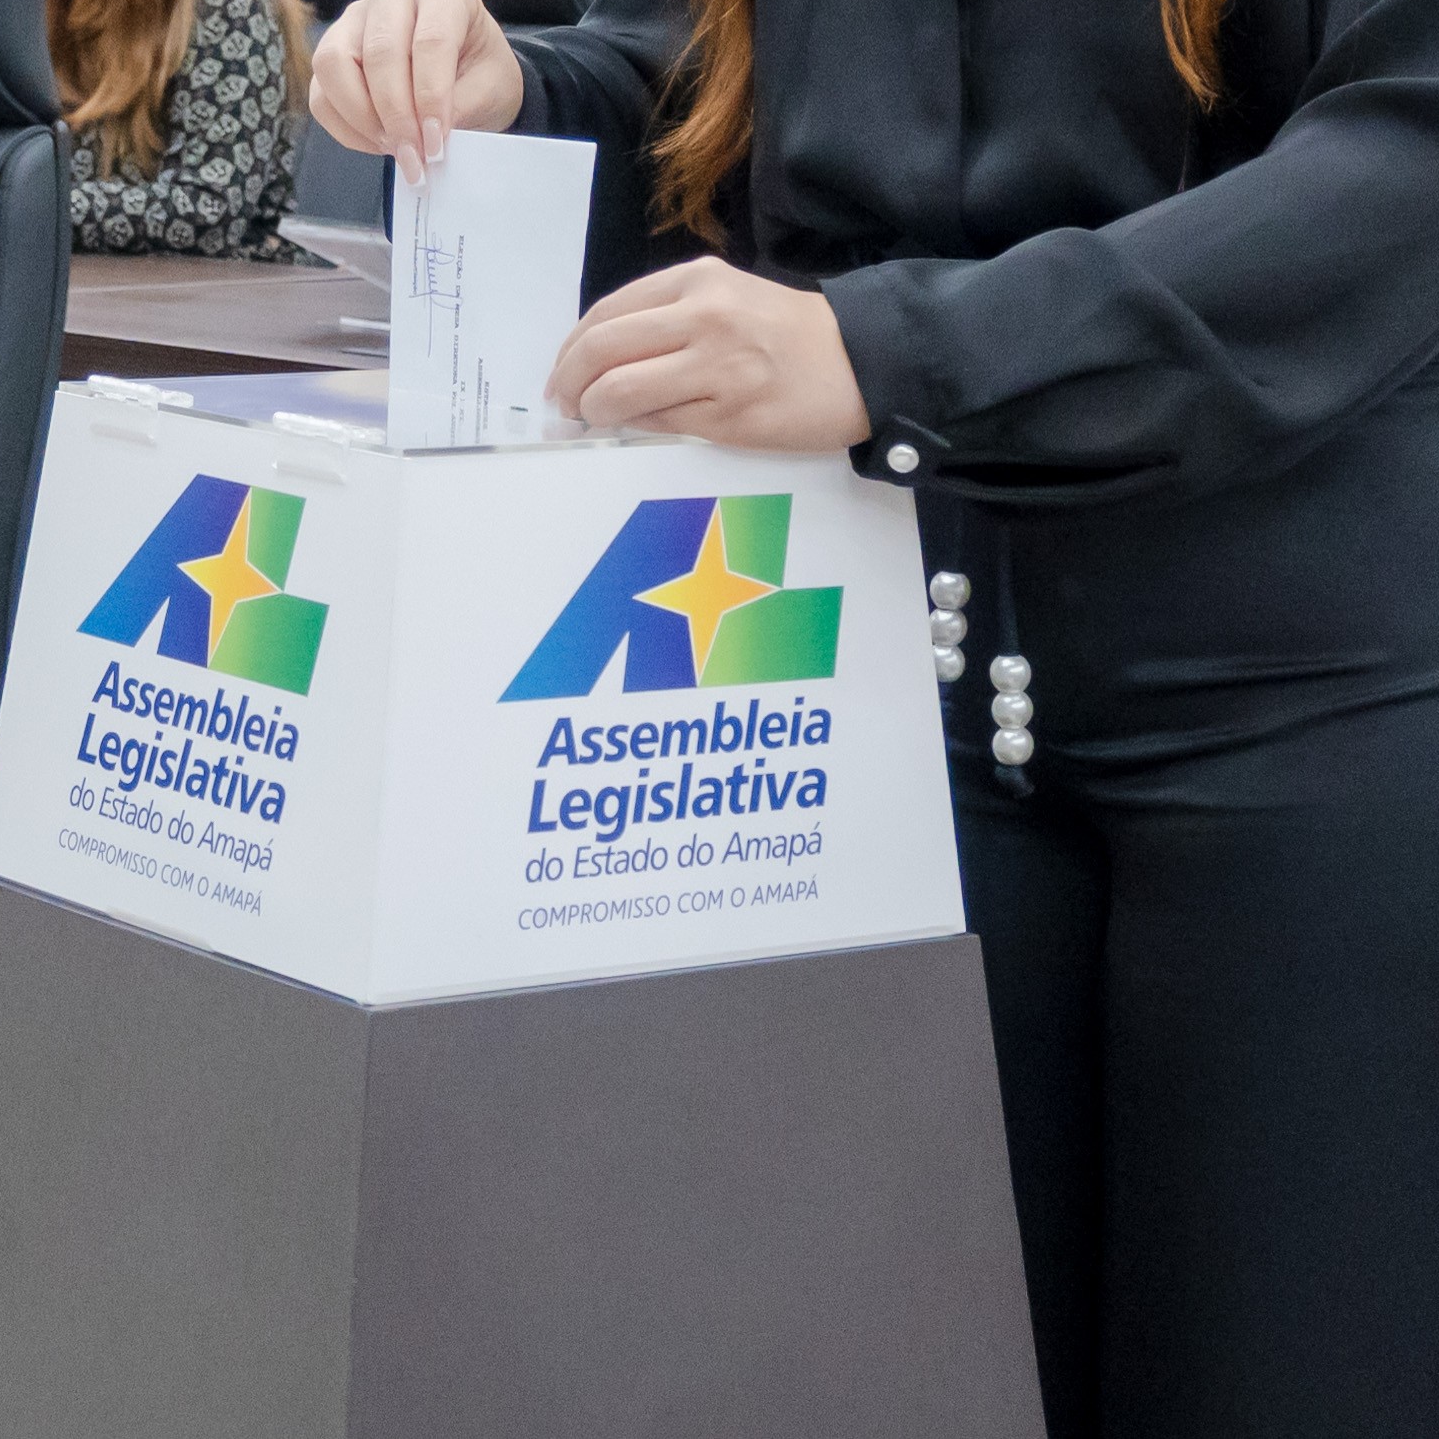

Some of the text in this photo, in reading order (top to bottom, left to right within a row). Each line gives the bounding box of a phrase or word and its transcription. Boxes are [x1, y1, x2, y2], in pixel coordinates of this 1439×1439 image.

[91, 660, 299, 762] Assembleia
[536, 696, 832, 768] Assembleia
[77, 712, 286, 824] Legislativa
[527, 757, 828, 843] Legislativa
[69, 777, 273, 873] do Estado do Amapá
[525, 821, 823, 883] do Estado do Amapá
[58, 828, 262, 916] COMPROMISSO COM O AMAPÁ
[518, 874, 819, 930] COMPROMISSO COM O AMAPÁ
